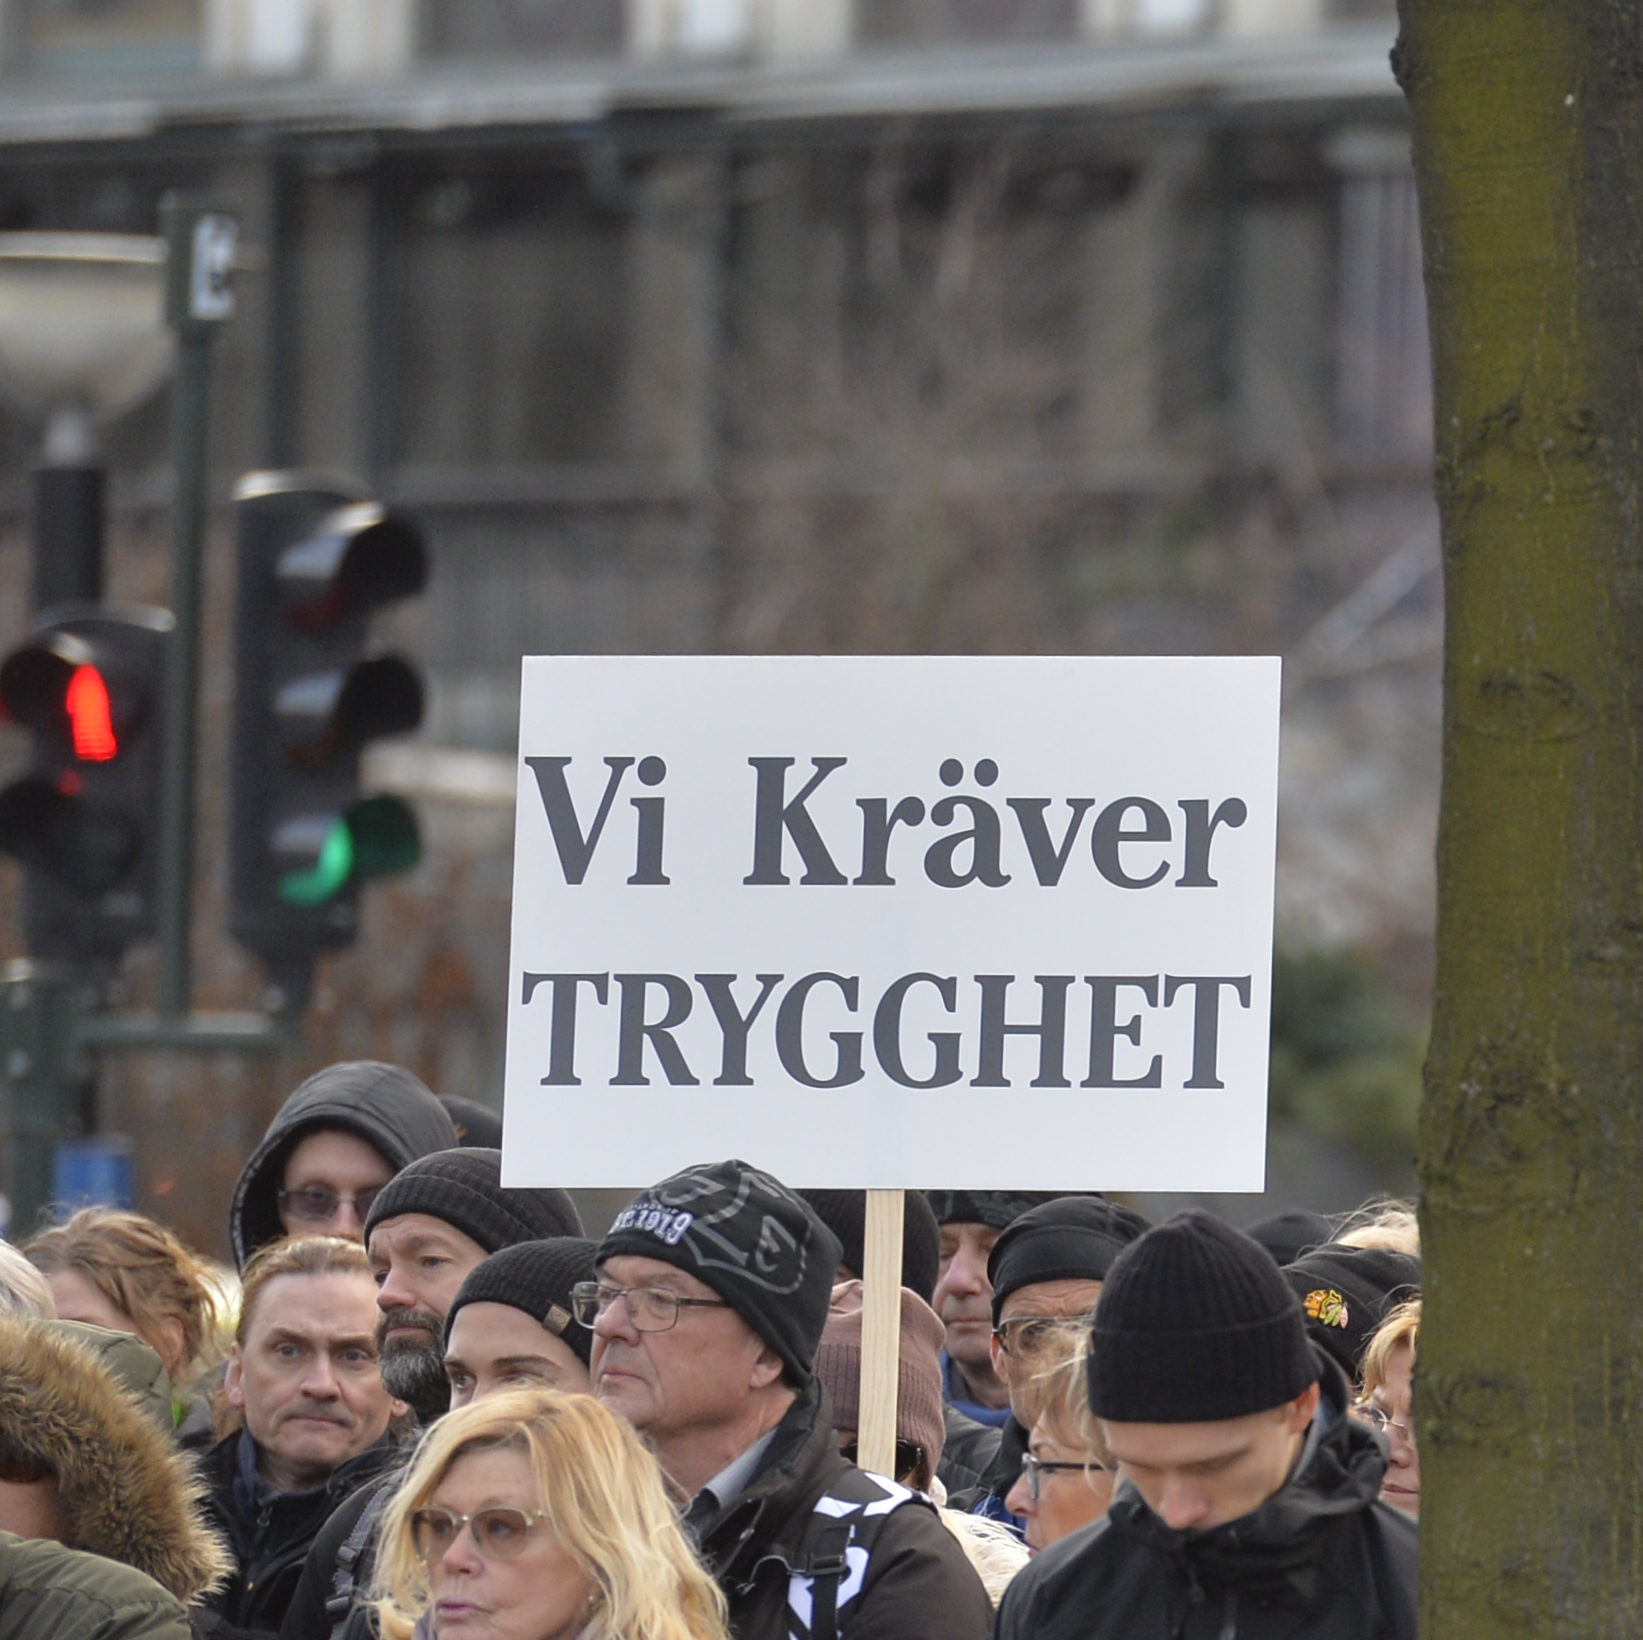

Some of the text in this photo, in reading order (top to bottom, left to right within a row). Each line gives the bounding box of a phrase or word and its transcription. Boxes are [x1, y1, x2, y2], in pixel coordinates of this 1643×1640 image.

[525, 756, 1246, 889] Vi Kräver
[522, 972, 1251, 1088] TRYGGHET
